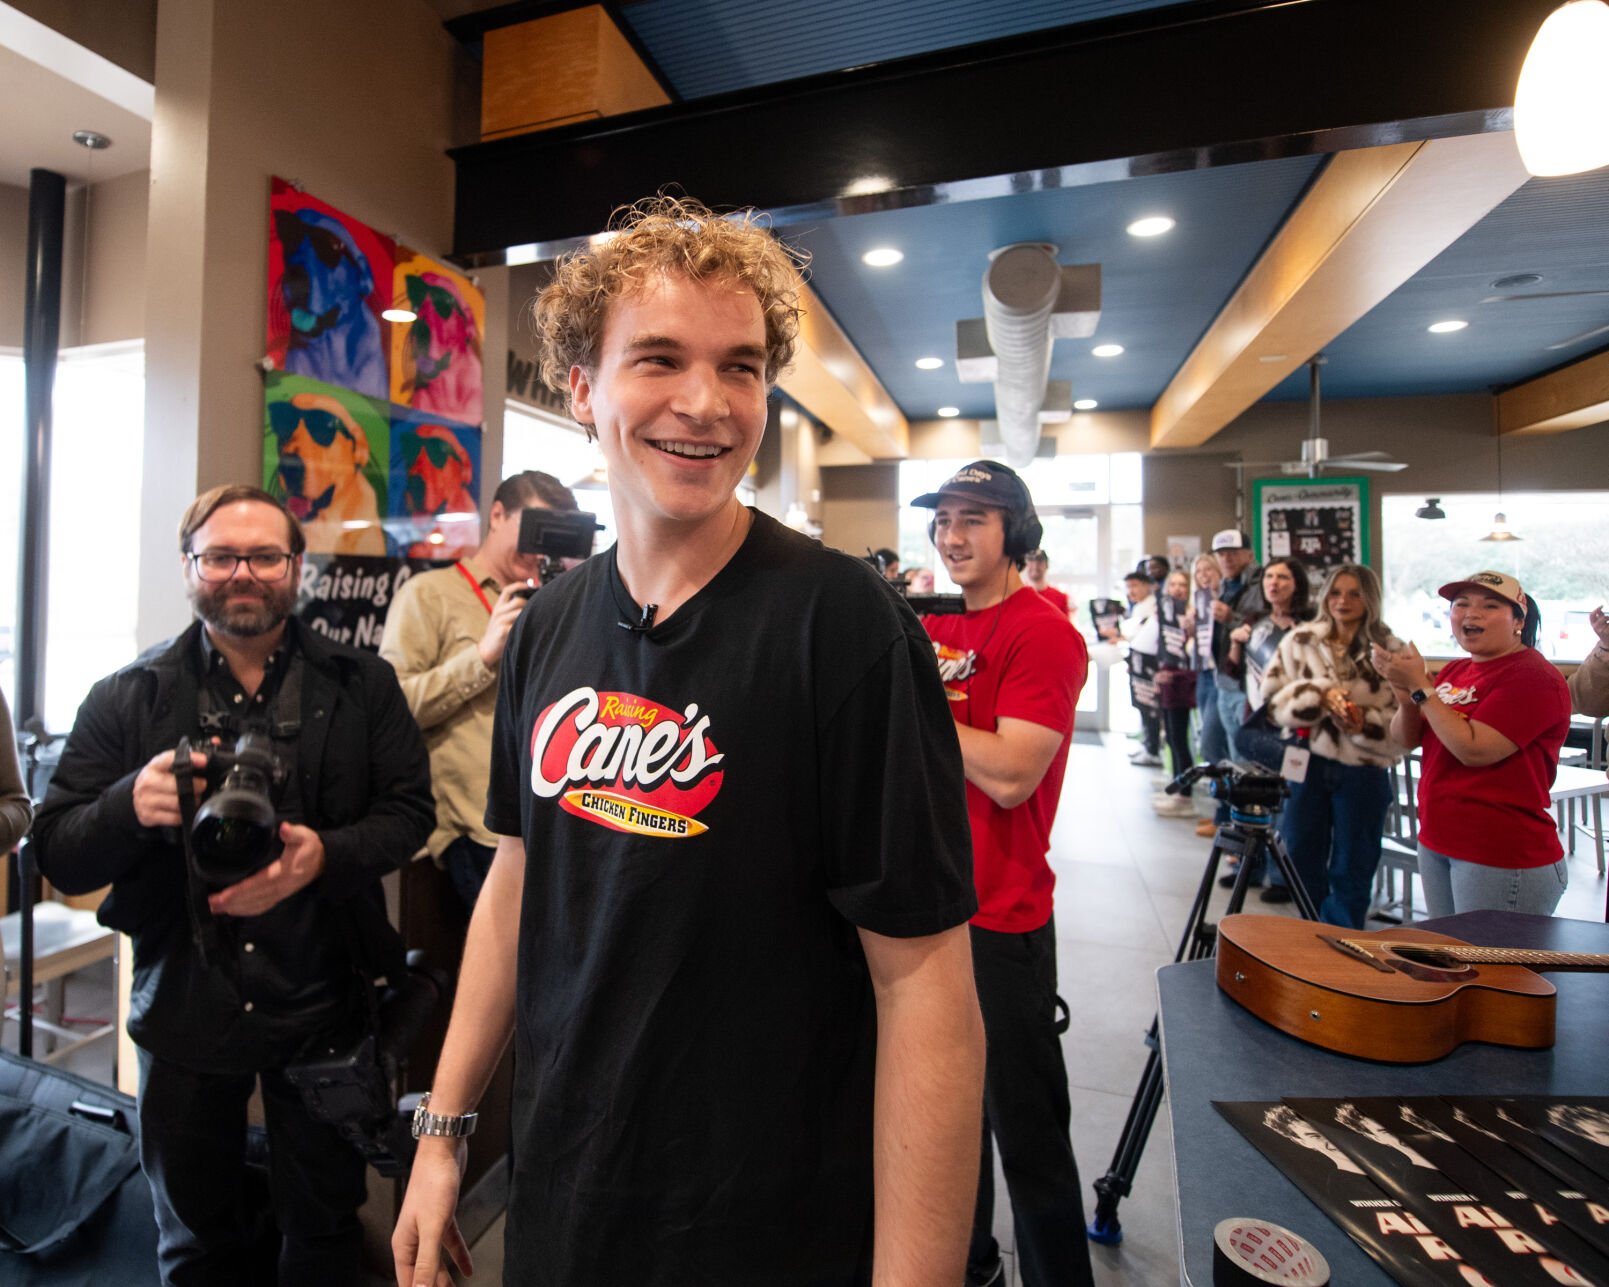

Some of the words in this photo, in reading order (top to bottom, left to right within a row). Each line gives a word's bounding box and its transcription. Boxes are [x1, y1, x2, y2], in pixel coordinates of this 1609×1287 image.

[298, 563, 390, 607] Raising
[353, 613, 386, 648] Na
[600, 696, 658, 728] Raising
[531, 687, 725, 798] Cane's
[581, 793, 626, 820] CHICKEN
[628, 807, 687, 834] FINGERS
